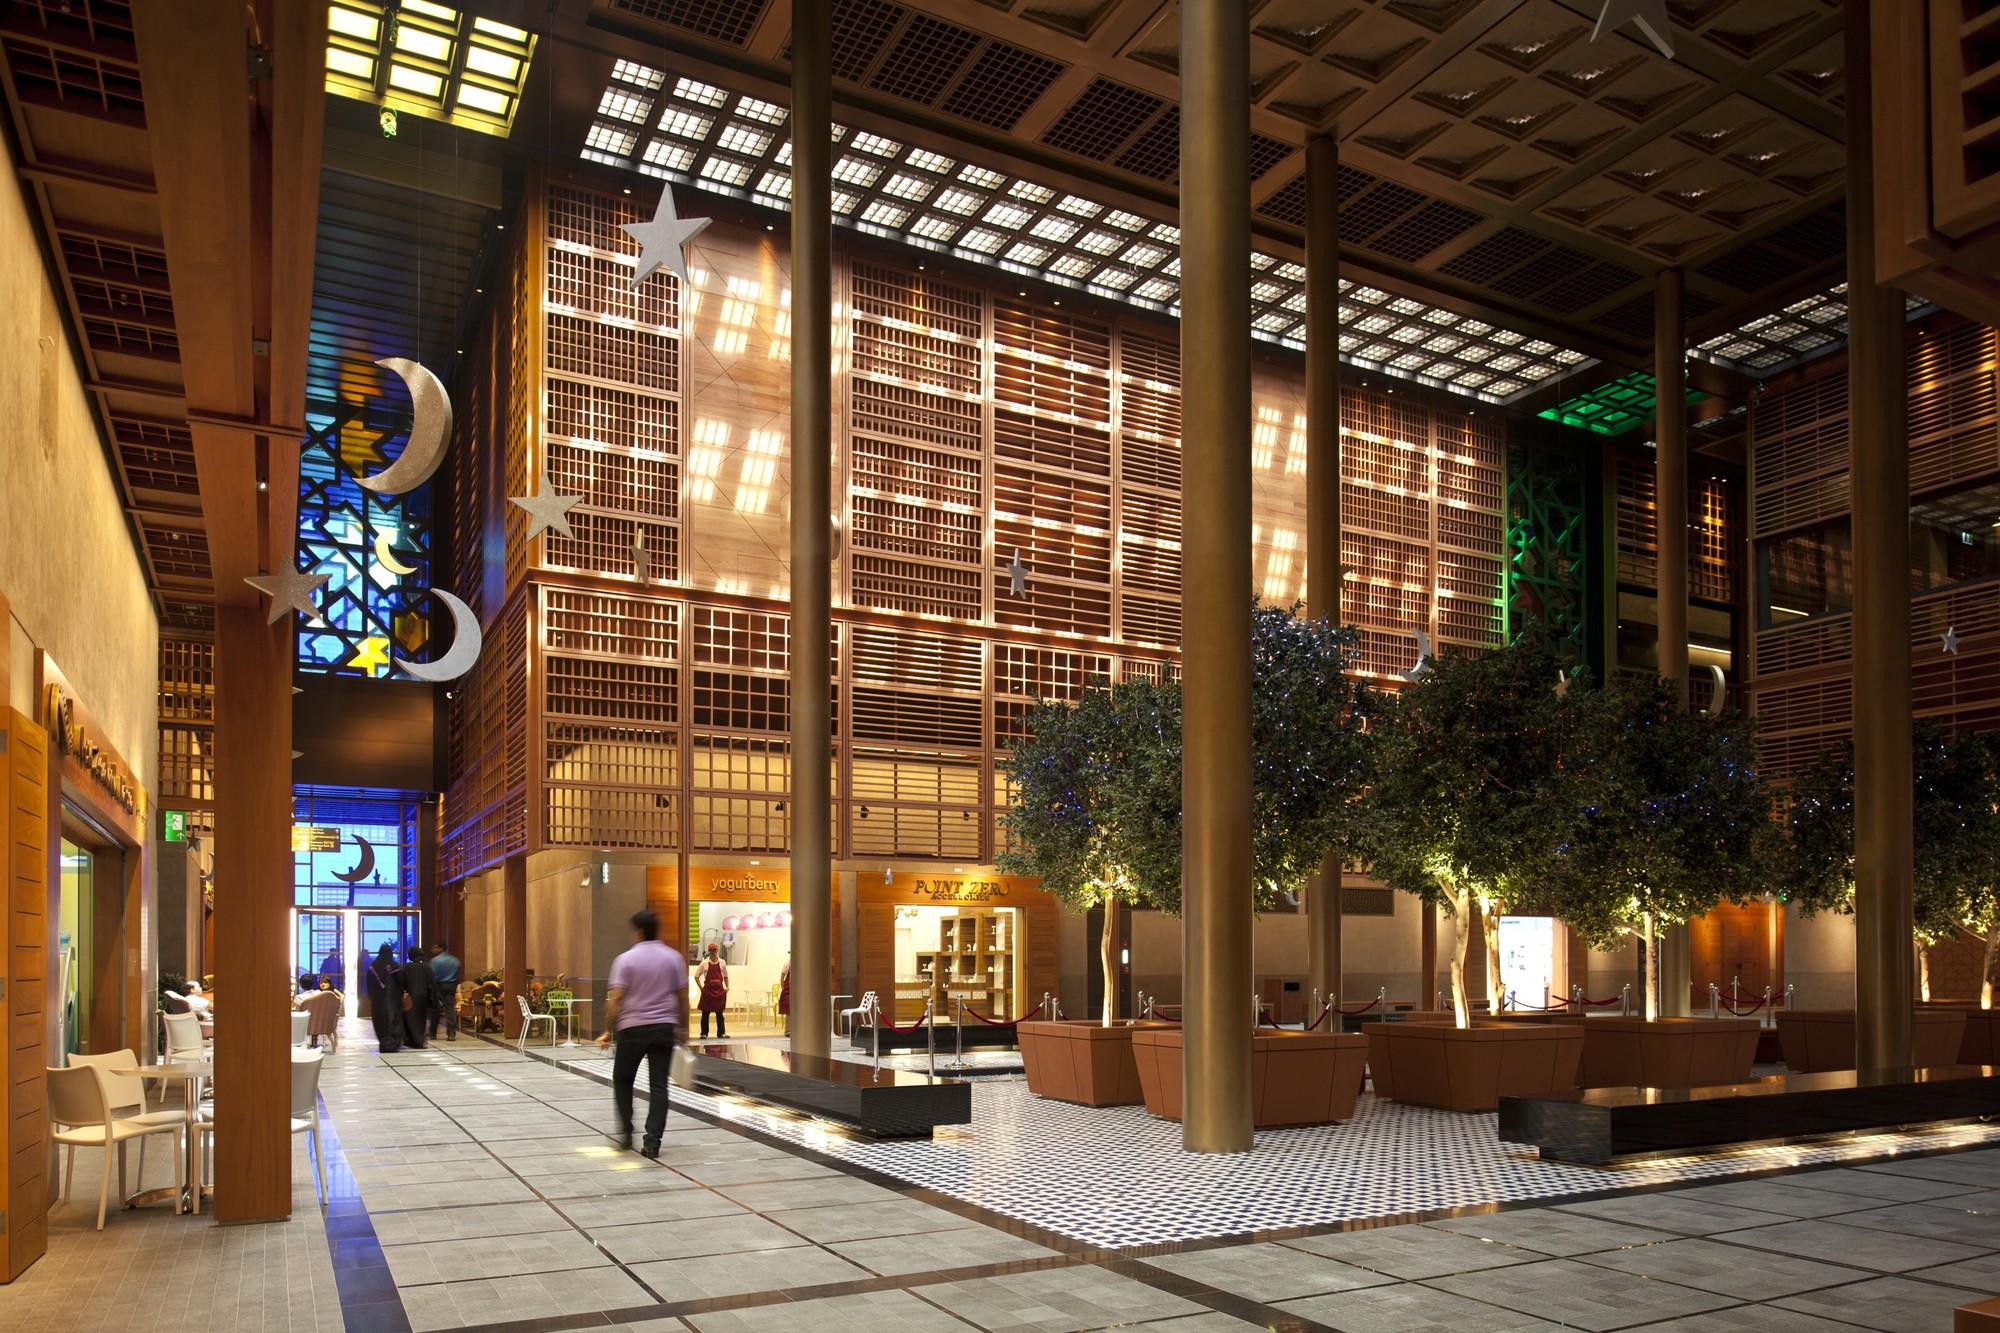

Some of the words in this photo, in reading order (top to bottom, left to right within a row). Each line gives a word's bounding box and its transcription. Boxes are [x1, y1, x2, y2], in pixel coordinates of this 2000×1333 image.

[711, 877, 781, 894] yogurberry
[913, 880, 964, 894] POINT
[968, 881, 1010, 896] ZERO
[930, 893, 990, 901] ACCESSORIES
